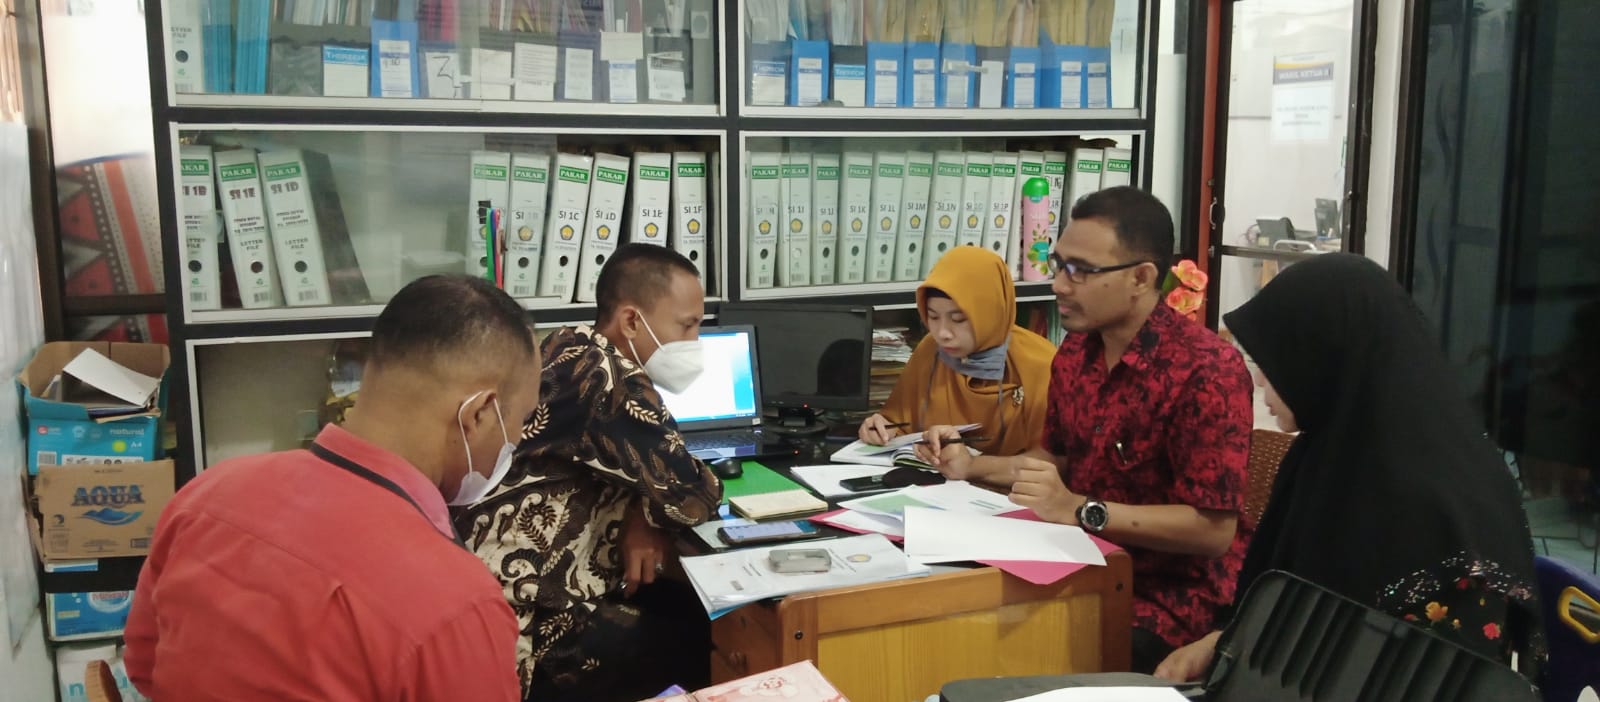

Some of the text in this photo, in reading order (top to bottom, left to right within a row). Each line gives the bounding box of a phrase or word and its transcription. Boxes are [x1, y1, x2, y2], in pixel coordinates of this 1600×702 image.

[181, 164, 206, 172] AKAR
[222, 168, 253, 178] PAKAR
[266, 167, 297, 177] PAKAR
[515, 170, 543, 179] PAKAR
[560, 170, 586, 180] PAKAR
[598, 170, 623, 180] PAKAR
[640, 169, 667, 178] PAKAR
[182, 185, 190, 196] I
[683, 205, 703, 214] SI 1F
[907, 202, 914, 210] SI
[515, 211, 525, 220] SI
[558, 210, 580, 221] SI 1C
[594, 210, 617, 221] SI 1D
[641, 208, 664, 218] SI 1E
[130, 440, 142, 448] A4
[70, 484, 146, 509] AQUA
